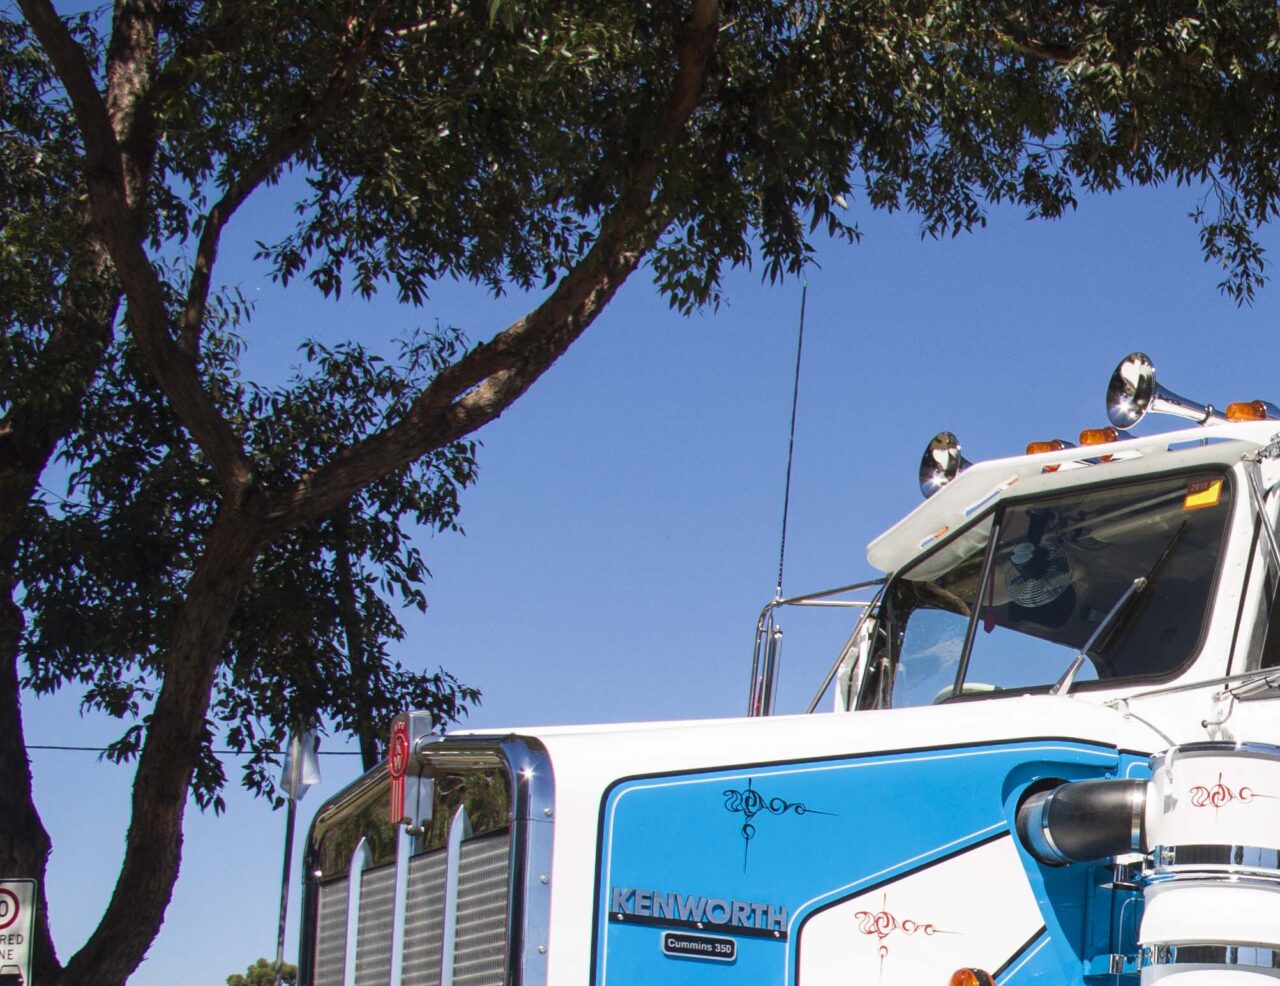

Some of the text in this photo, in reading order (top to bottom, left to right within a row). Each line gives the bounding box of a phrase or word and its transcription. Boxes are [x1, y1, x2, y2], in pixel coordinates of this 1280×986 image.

[611, 886, 789, 932] KENWORTH
[667, 938, 732, 954] Cummins 350
